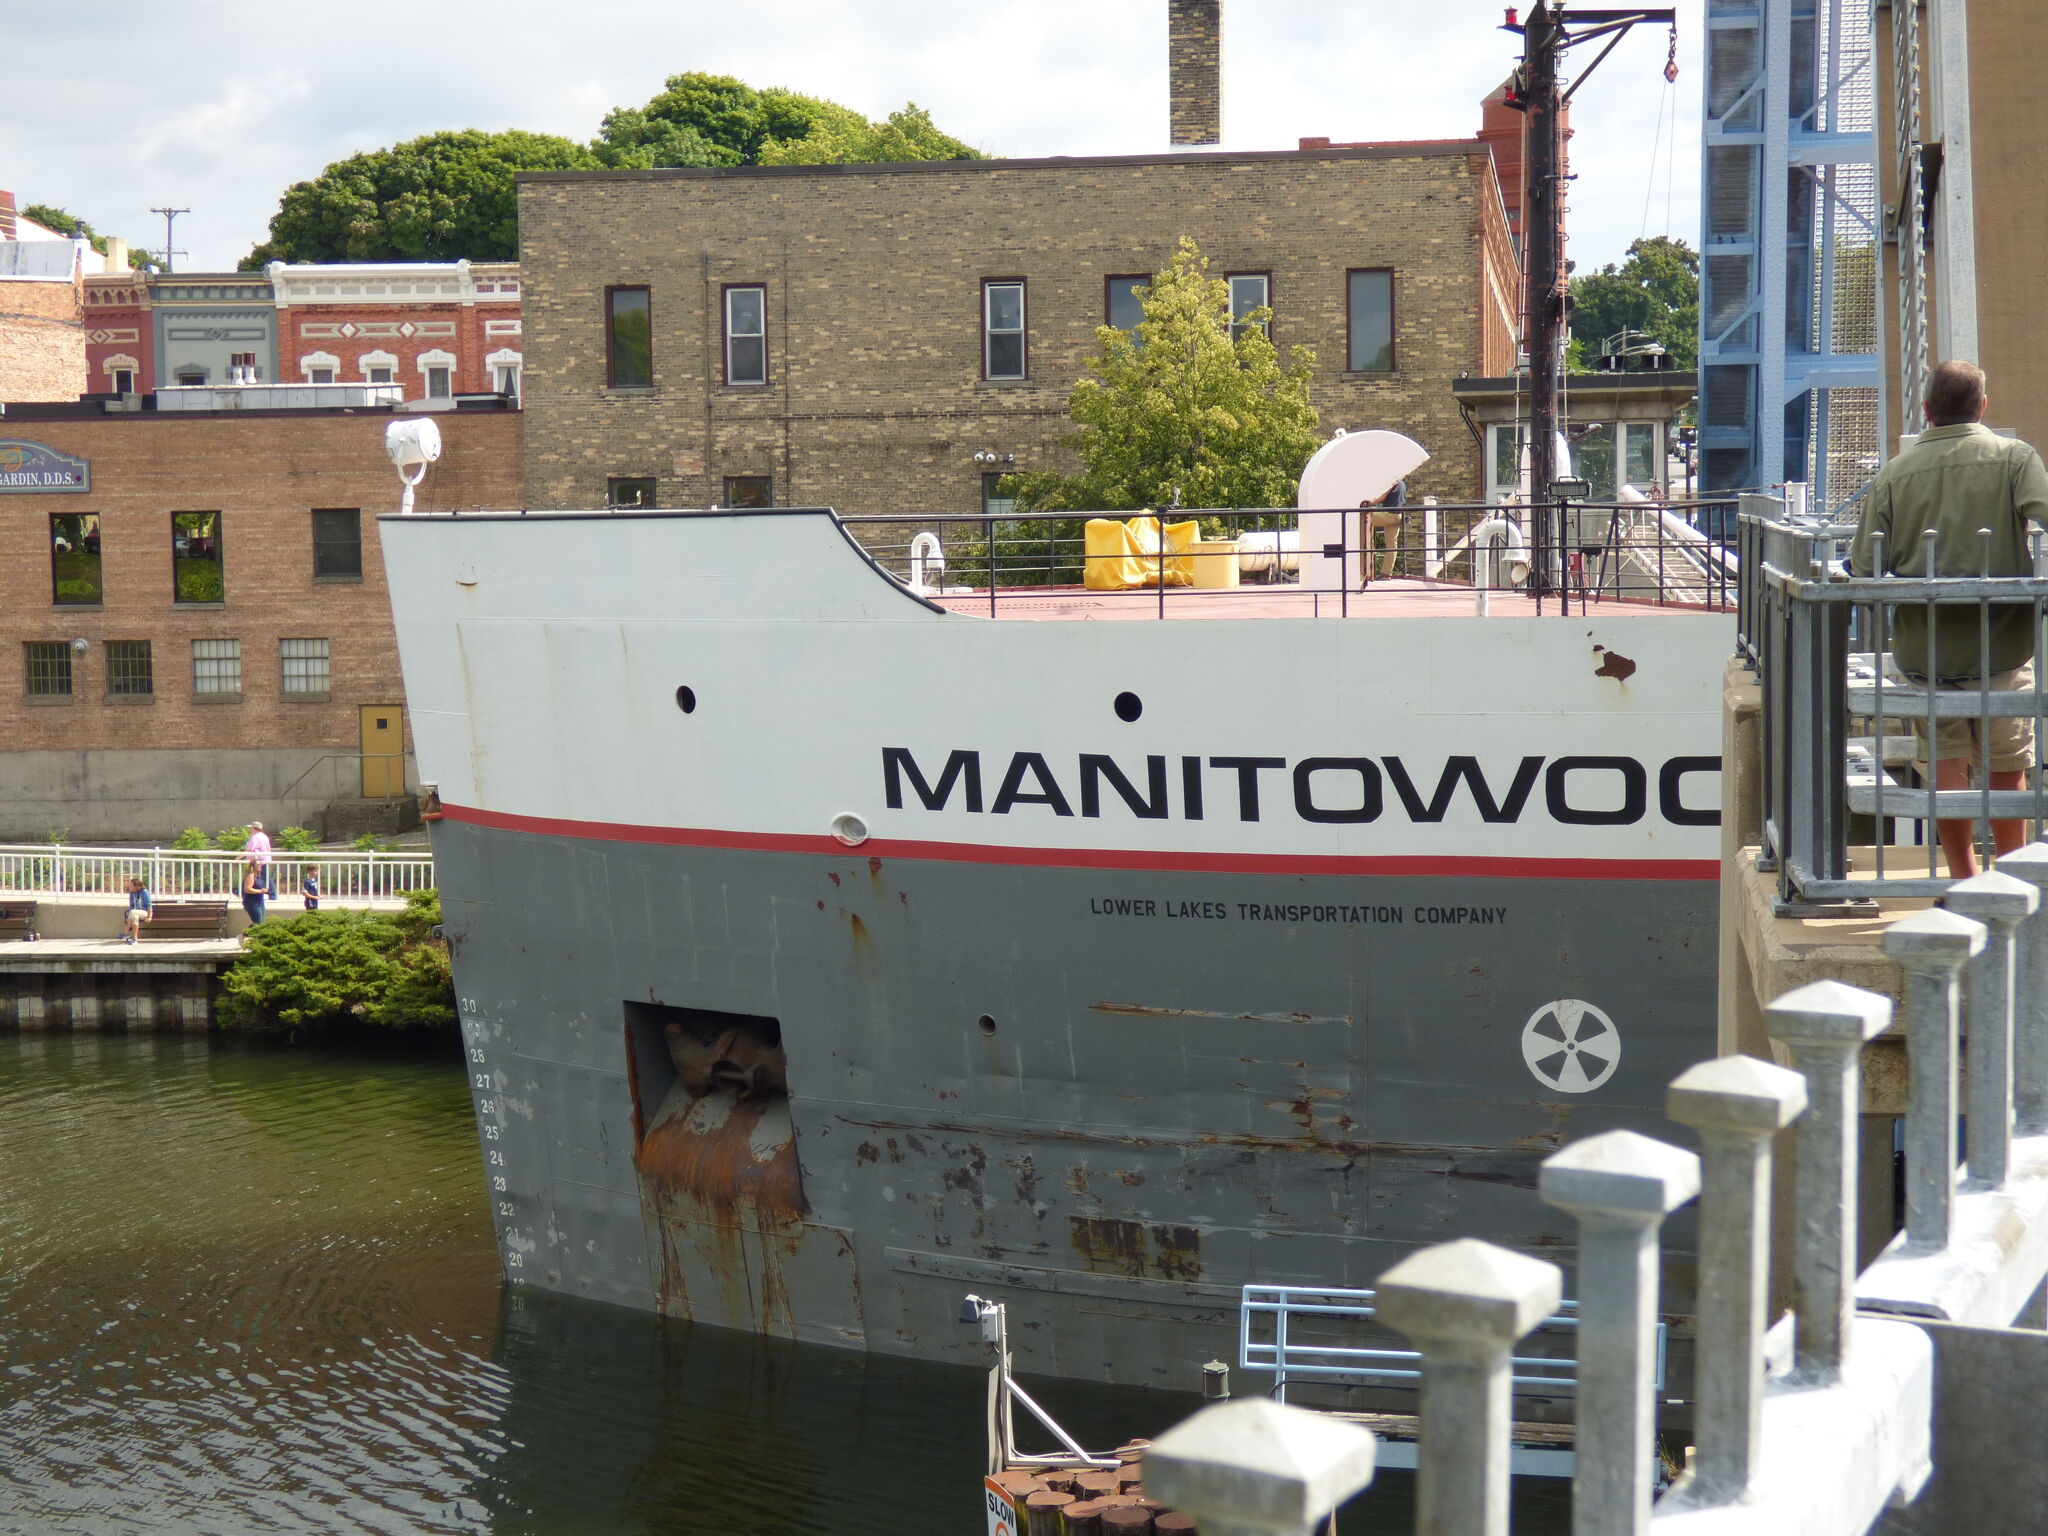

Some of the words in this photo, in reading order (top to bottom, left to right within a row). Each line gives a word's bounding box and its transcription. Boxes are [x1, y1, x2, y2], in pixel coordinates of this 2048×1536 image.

[44, 471, 75, 485] D.D.S.
[1090, 897, 1157, 917] LOWER
[1166, 900, 1227, 920] LAKES
[1237, 903, 1403, 924] TRANSPORTATION
[1414, 906, 1507, 925] COMPANY
[461, 998, 477, 1013] 30
[470, 1048, 485, 1064] 28
[475, 1073, 490, 1089] 27
[485, 1125, 499, 1140] 25
[490, 1150, 504, 1166] 24
[493, 1175, 507, 1192] 23
[499, 1201, 515, 1217] 22
[509, 1252, 523, 1268] 20
[988, 1492, 1015, 1529] SLOW
